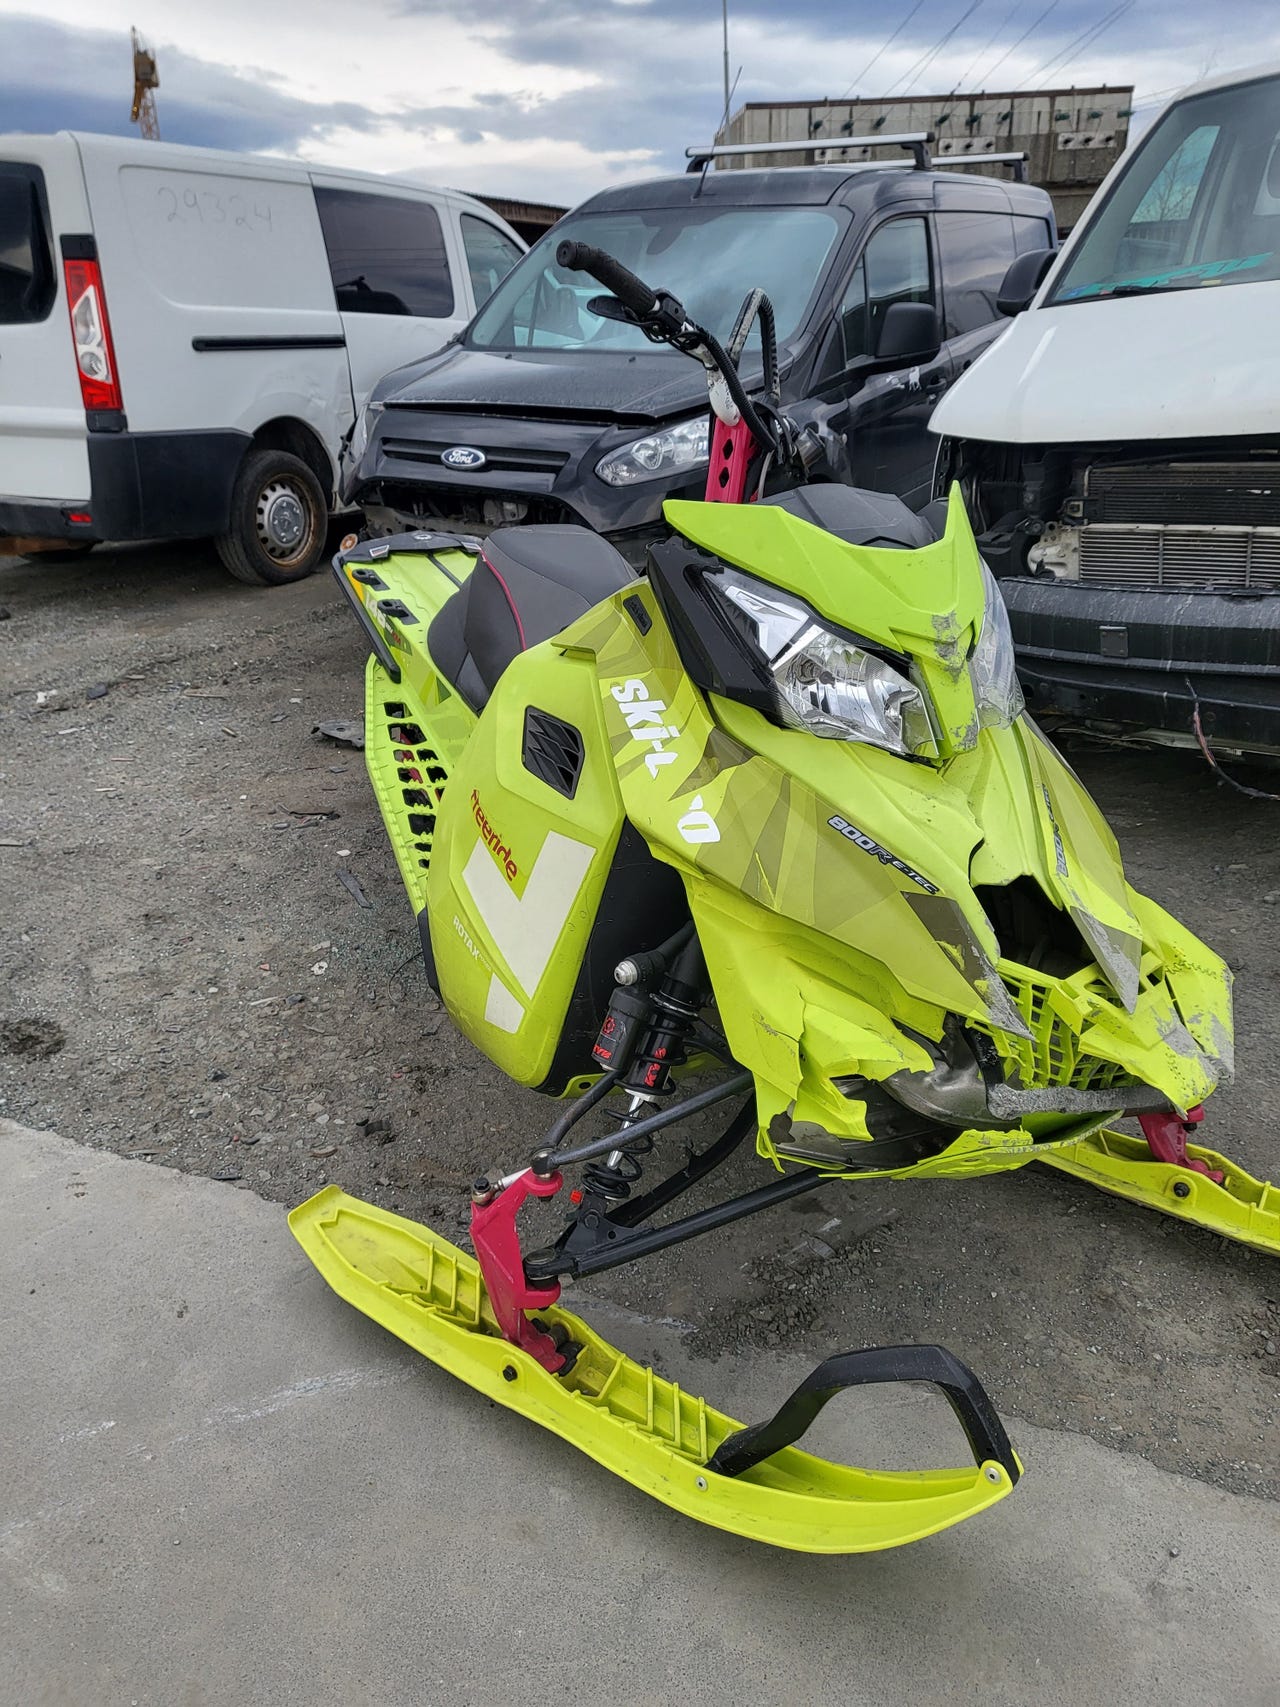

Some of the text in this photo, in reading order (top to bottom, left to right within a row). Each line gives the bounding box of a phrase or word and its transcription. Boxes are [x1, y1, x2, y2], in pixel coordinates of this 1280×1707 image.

[448, 449, 474, 464] Ford
[828, 815, 939, 894] 800R E-TEC
[453, 915, 480, 961] ROTAX
